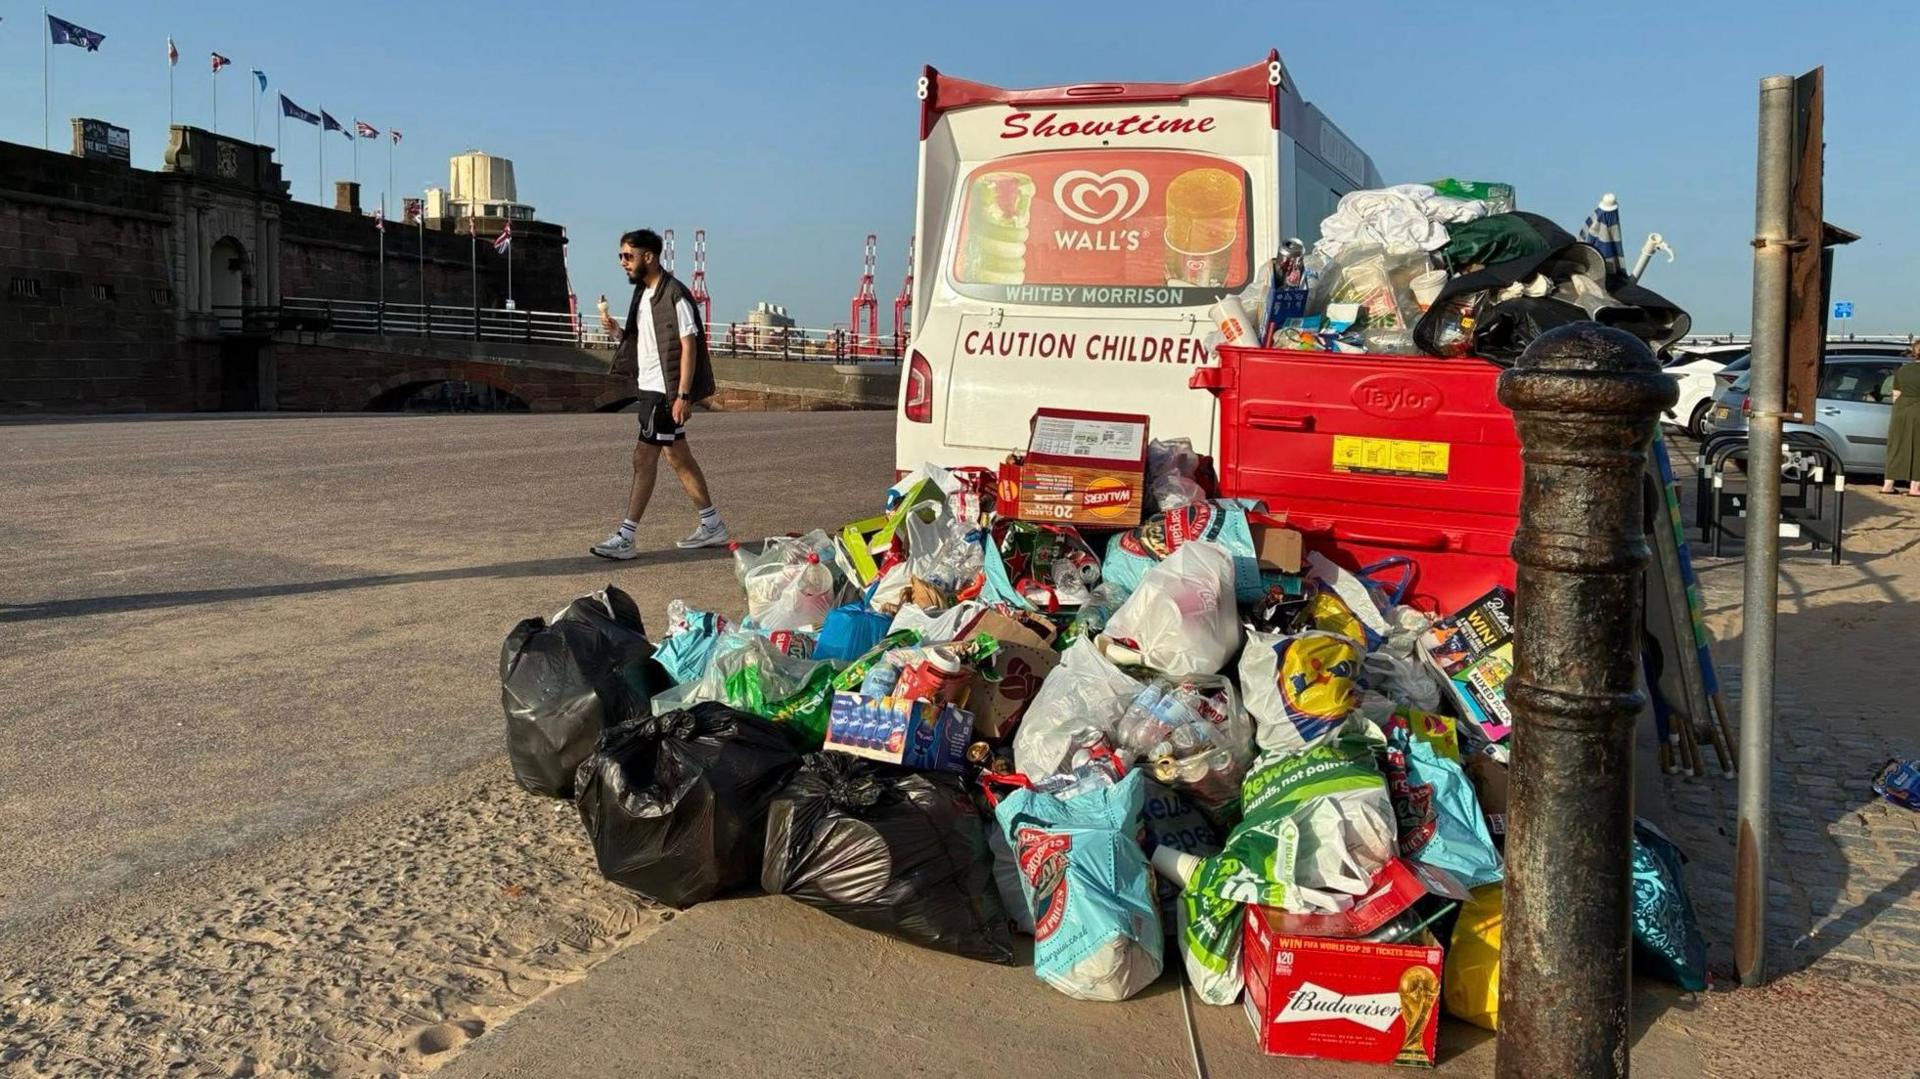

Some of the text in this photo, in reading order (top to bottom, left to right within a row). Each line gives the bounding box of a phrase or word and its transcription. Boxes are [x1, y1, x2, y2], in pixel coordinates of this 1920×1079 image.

[1000, 112, 1217, 139] Showtime
[1054, 229, 1141, 251] WALL'S
[1006, 285, 1184, 304] WHITBY MORRISON
[964, 330, 1210, 365] CAUTION CHILDREN
[1361, 386, 1434, 412] Taylor
[1084, 489, 1131, 505] WALKERS
[1054, 505, 1073, 519] 20
[1467, 609, 1498, 647] WIN!
[1486, 596, 1515, 634] Butlin's
[1470, 672, 1496, 700] MIXED
[1492, 697, 1513, 725] PACK
[1281, 770, 1306, 788] not
[1279, 938, 1303, 949] WIN
[1303, 941, 1319, 949] FIFA
[1319, 942, 1346, 951] WORLD
[1375, 947, 1404, 957] TICKETS
[1287, 989, 1403, 1019] Budweiser
